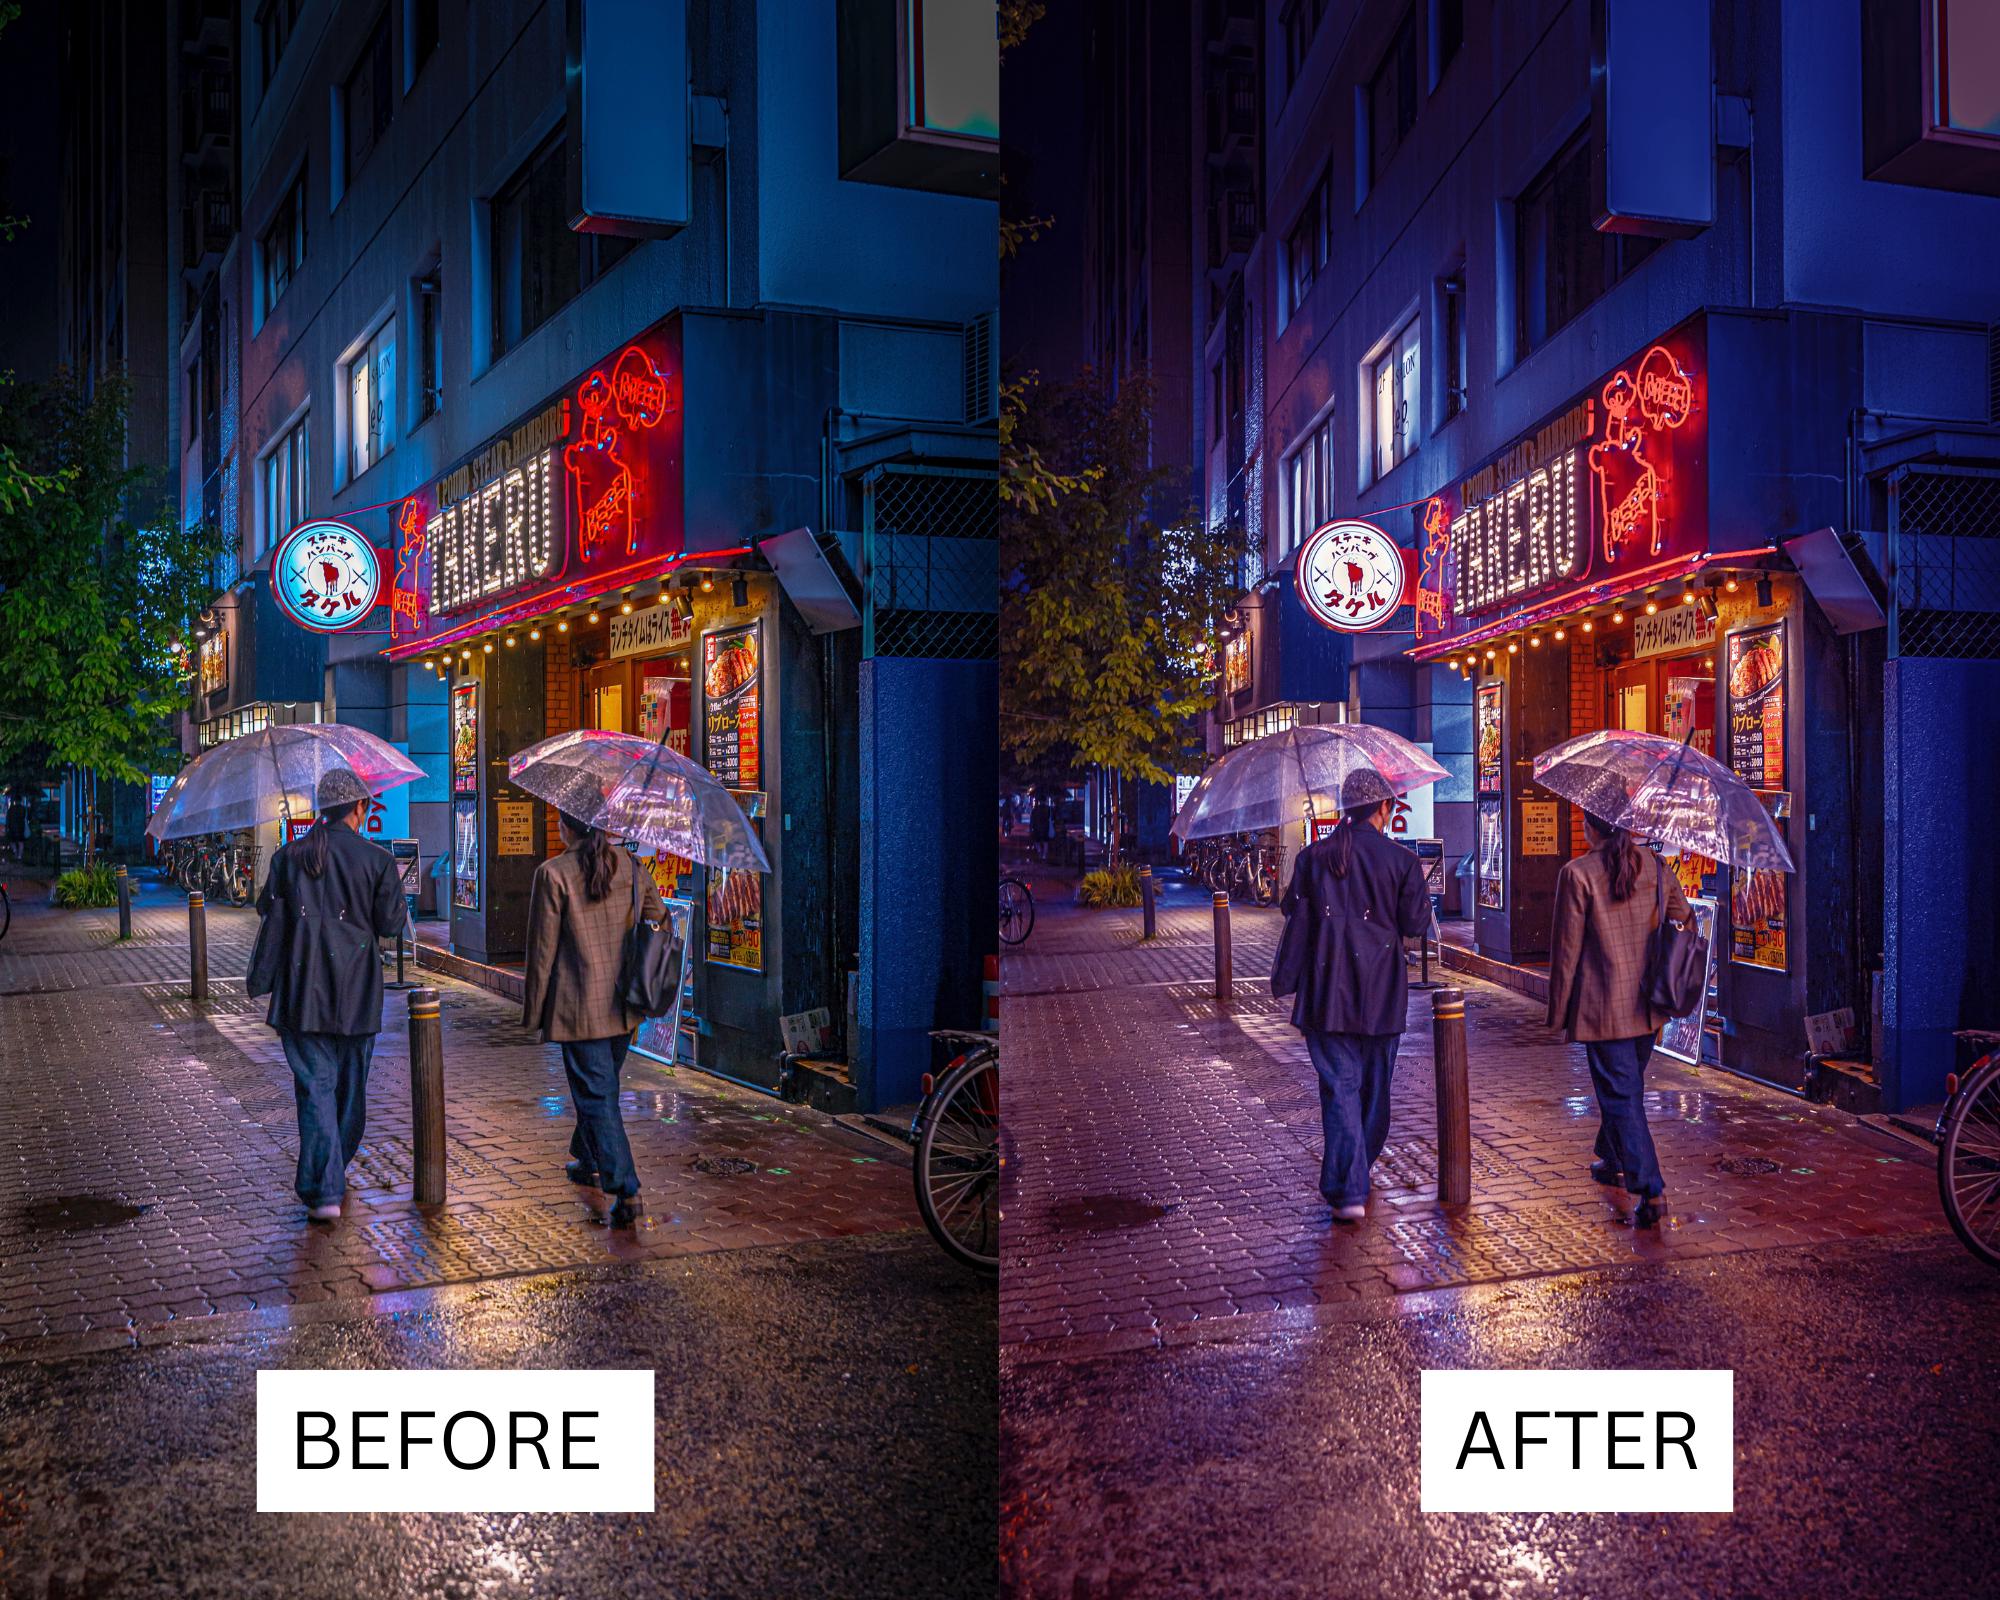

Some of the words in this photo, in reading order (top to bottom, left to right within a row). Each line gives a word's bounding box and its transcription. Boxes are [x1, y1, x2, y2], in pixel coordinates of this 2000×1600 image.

[442, 464, 469, 507] POUND
[512, 399, 570, 465] HAMBURG
[1466, 464, 1493, 507] POUND
[1536, 399, 1594, 465] HAMBURG
[307, 533, 347, 547] ステーキ
[427, 448, 551, 616] TAKERU
[1331, 533, 1371, 547] ステーキ
[1451, 448, 1575, 616] TAKERU
[307, 544, 354, 561] ハンバーグ
[1331, 544, 1378, 561] ハンバーグ
[300, 589, 361, 617] タケル
[1324, 589, 1385, 617] タケル
